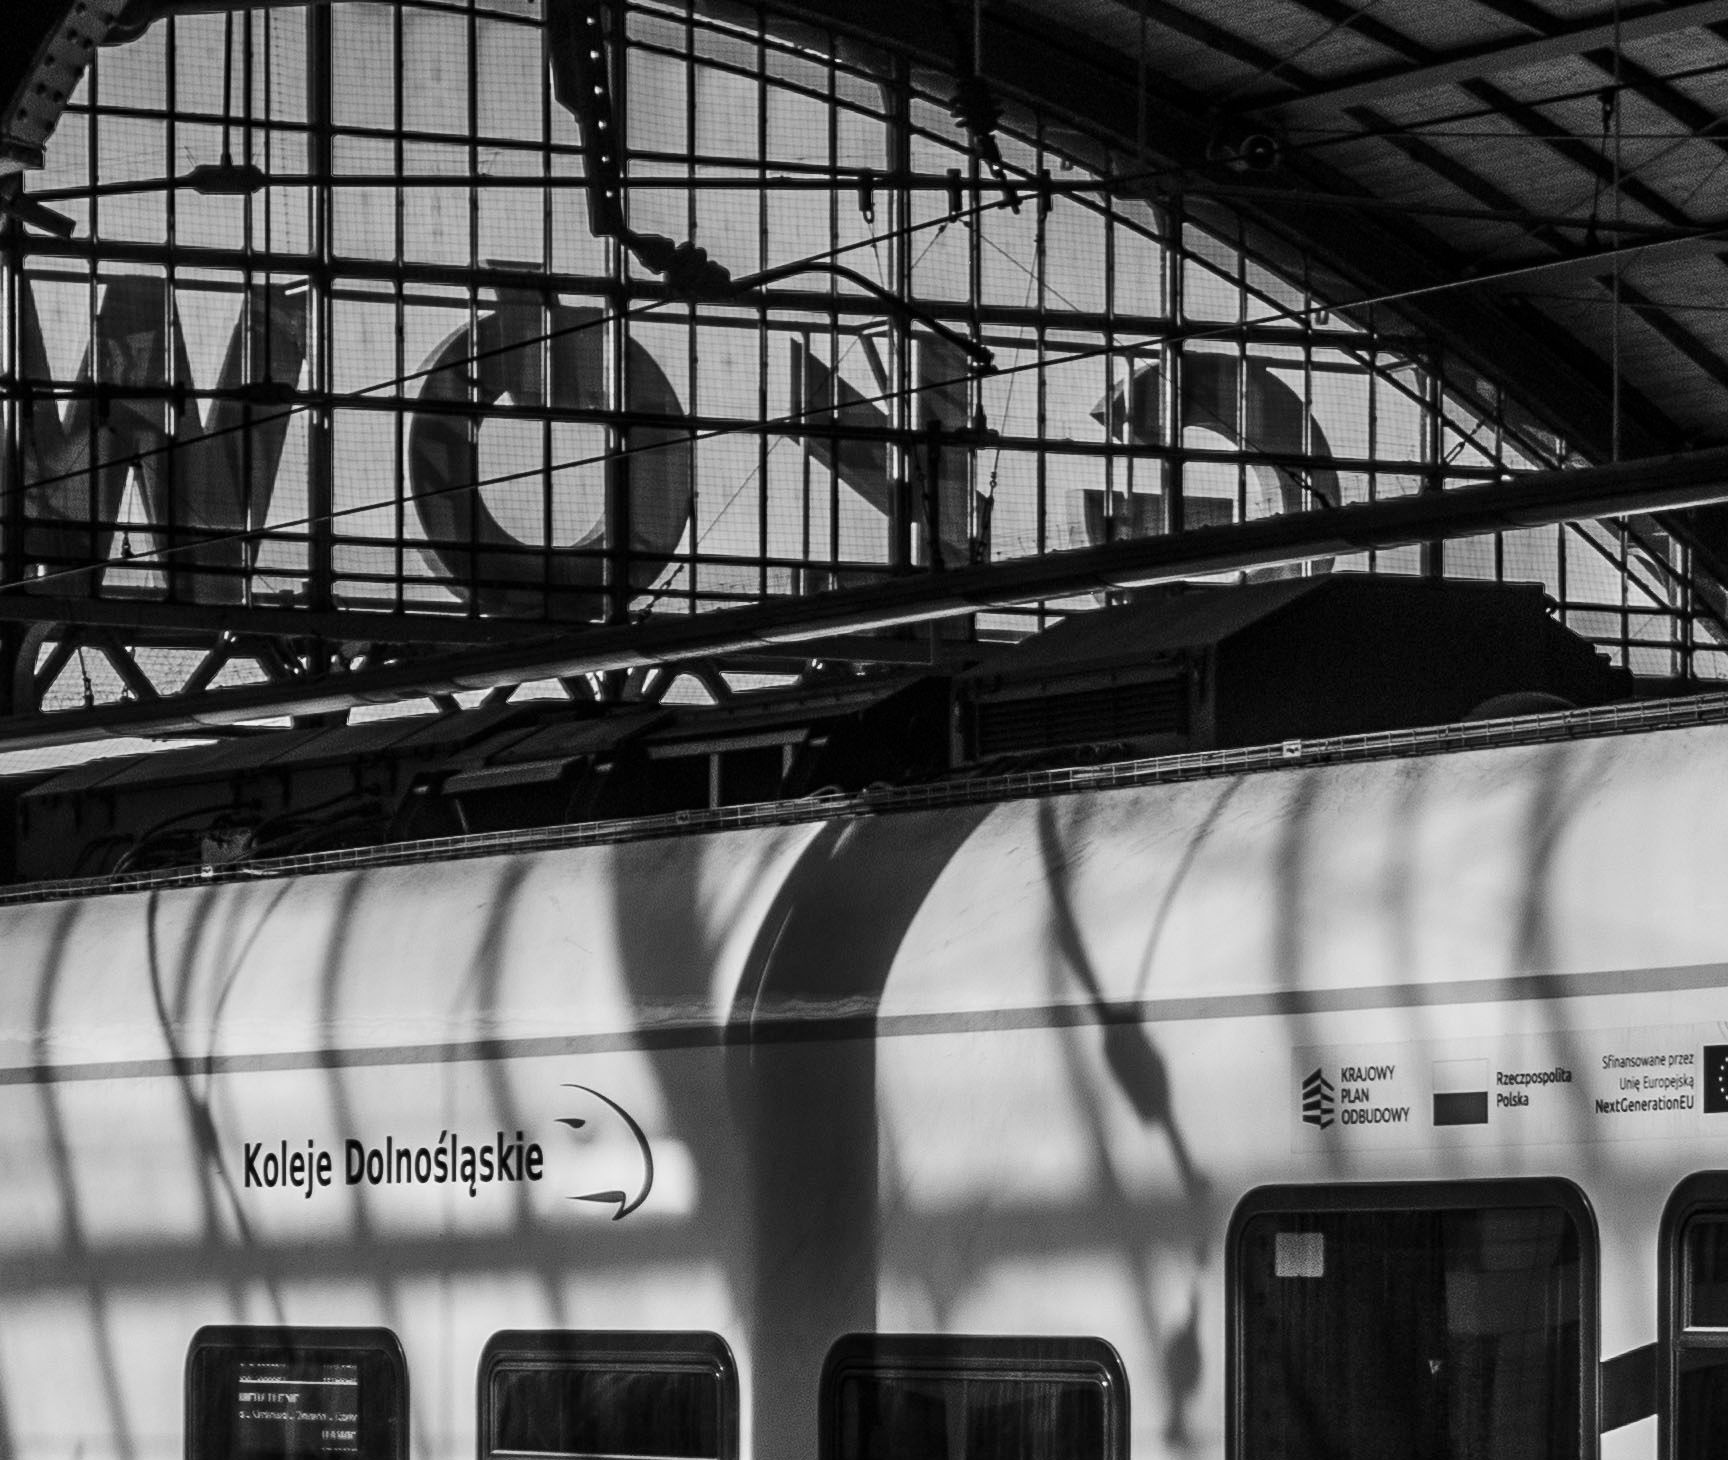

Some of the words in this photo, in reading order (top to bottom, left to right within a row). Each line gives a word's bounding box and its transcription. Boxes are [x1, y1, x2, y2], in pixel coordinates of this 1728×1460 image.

[1602, 1053, 1666, 1070] Sfinansowane
[1668, 1053, 1694, 1068] przez
[1340, 1065, 1395, 1083] KRAJOWY
[1496, 1067, 1572, 1088] Rzeczpospolita
[1619, 1077, 1640, 1092] Unię
[1643, 1073, 1694, 1091] Europejską
[1340, 1088, 1369, 1104] PLAN
[1496, 1091, 1529, 1107] Polska
[1595, 1095, 1694, 1114] NextGenerationEU
[1340, 1107, 1410, 1125] ODBUDOWY
[244, 1139, 332, 1199] Koleje
[344, 1130, 544, 1198] Dolnośląskie
